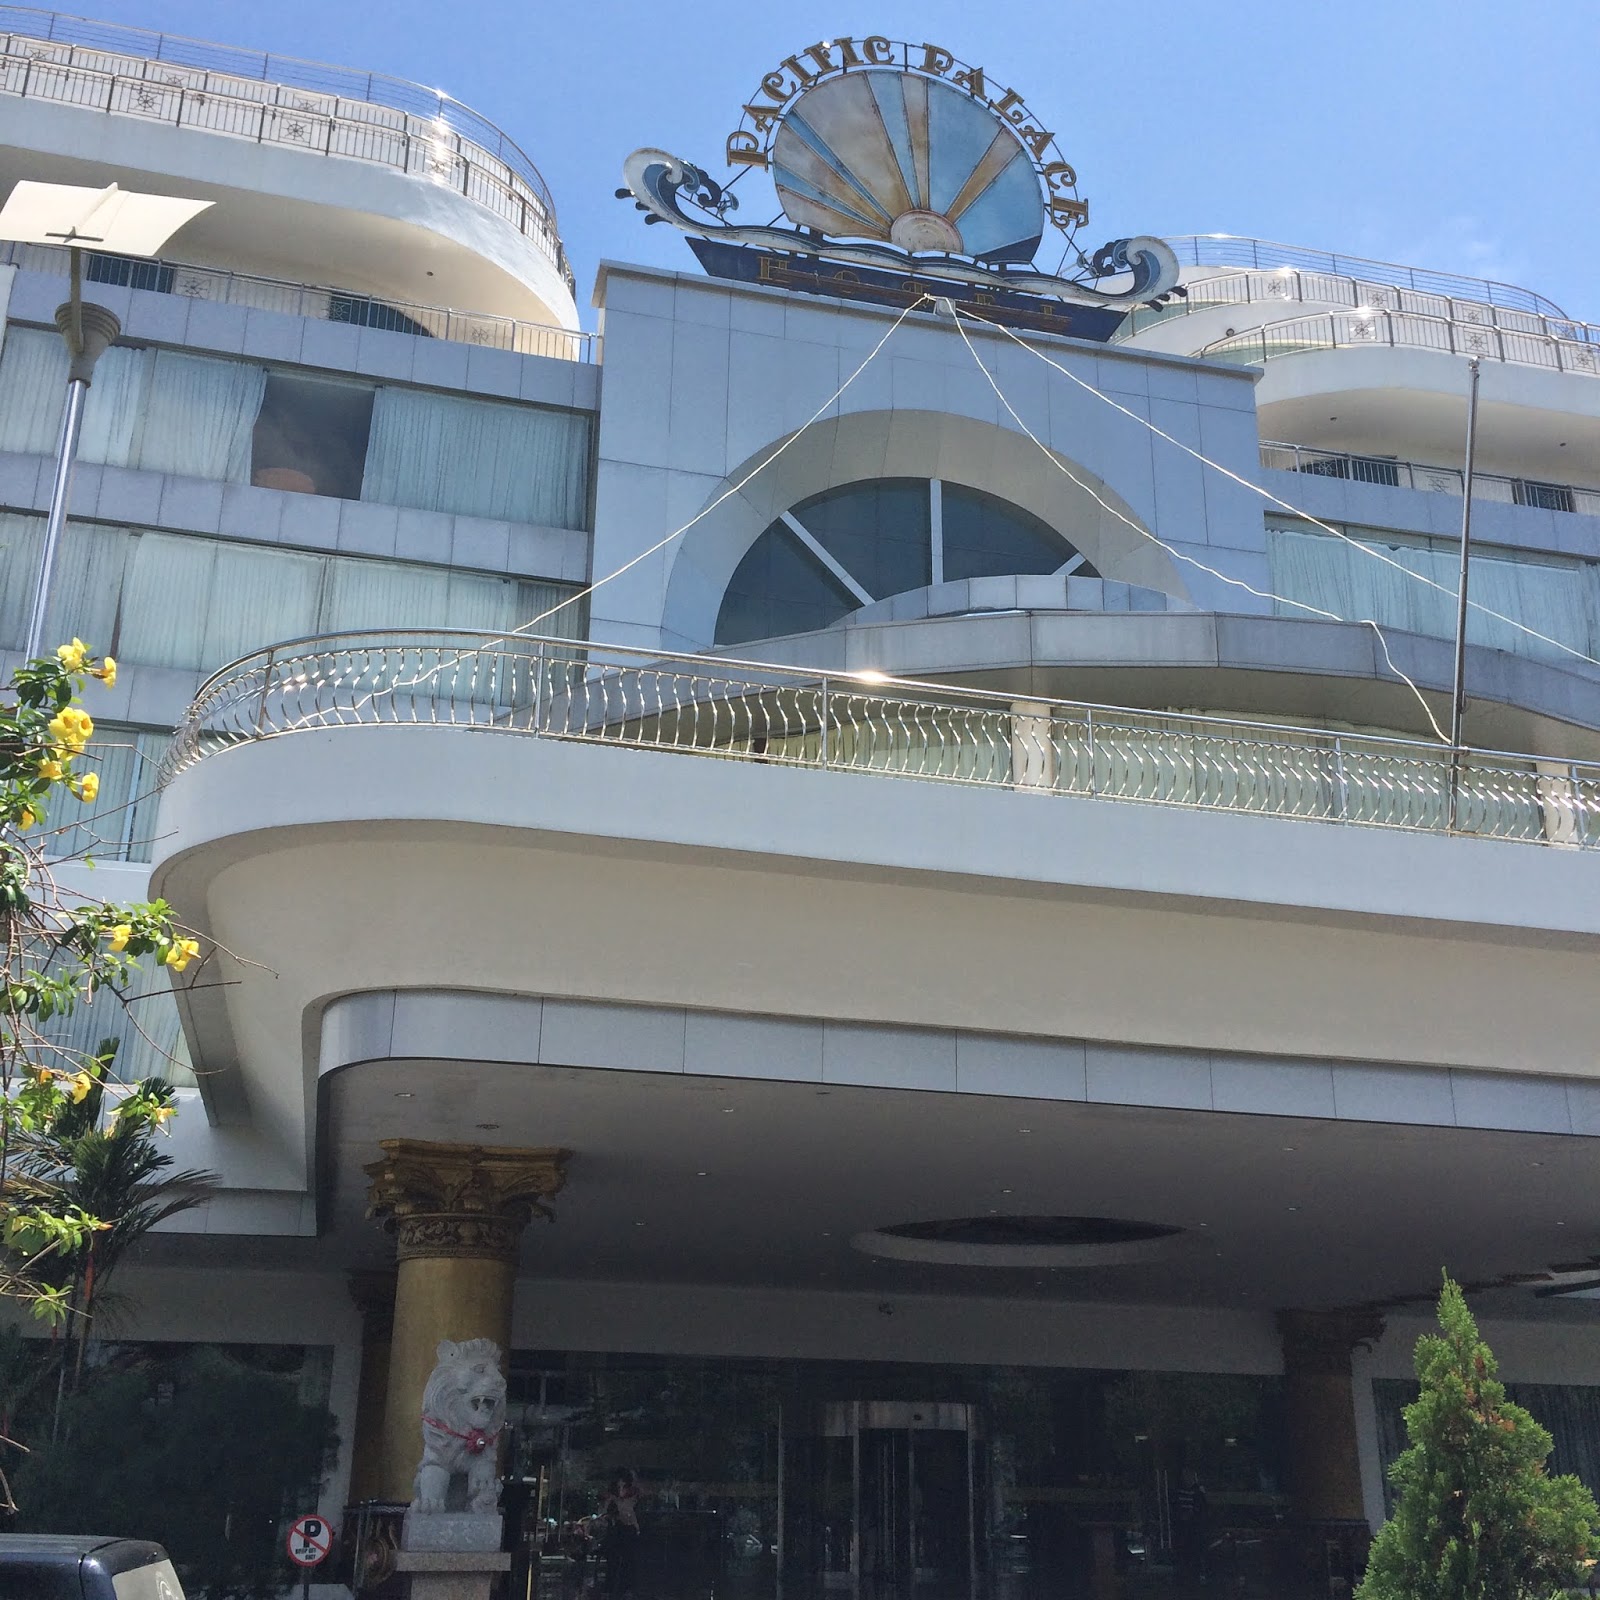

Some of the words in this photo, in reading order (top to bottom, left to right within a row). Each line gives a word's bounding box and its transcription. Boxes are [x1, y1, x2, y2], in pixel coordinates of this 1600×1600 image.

[726, 36, 895, 173] PACIFIC
[919, 42, 1089, 229] PALACE
[303, 1520, 322, 1548] P
